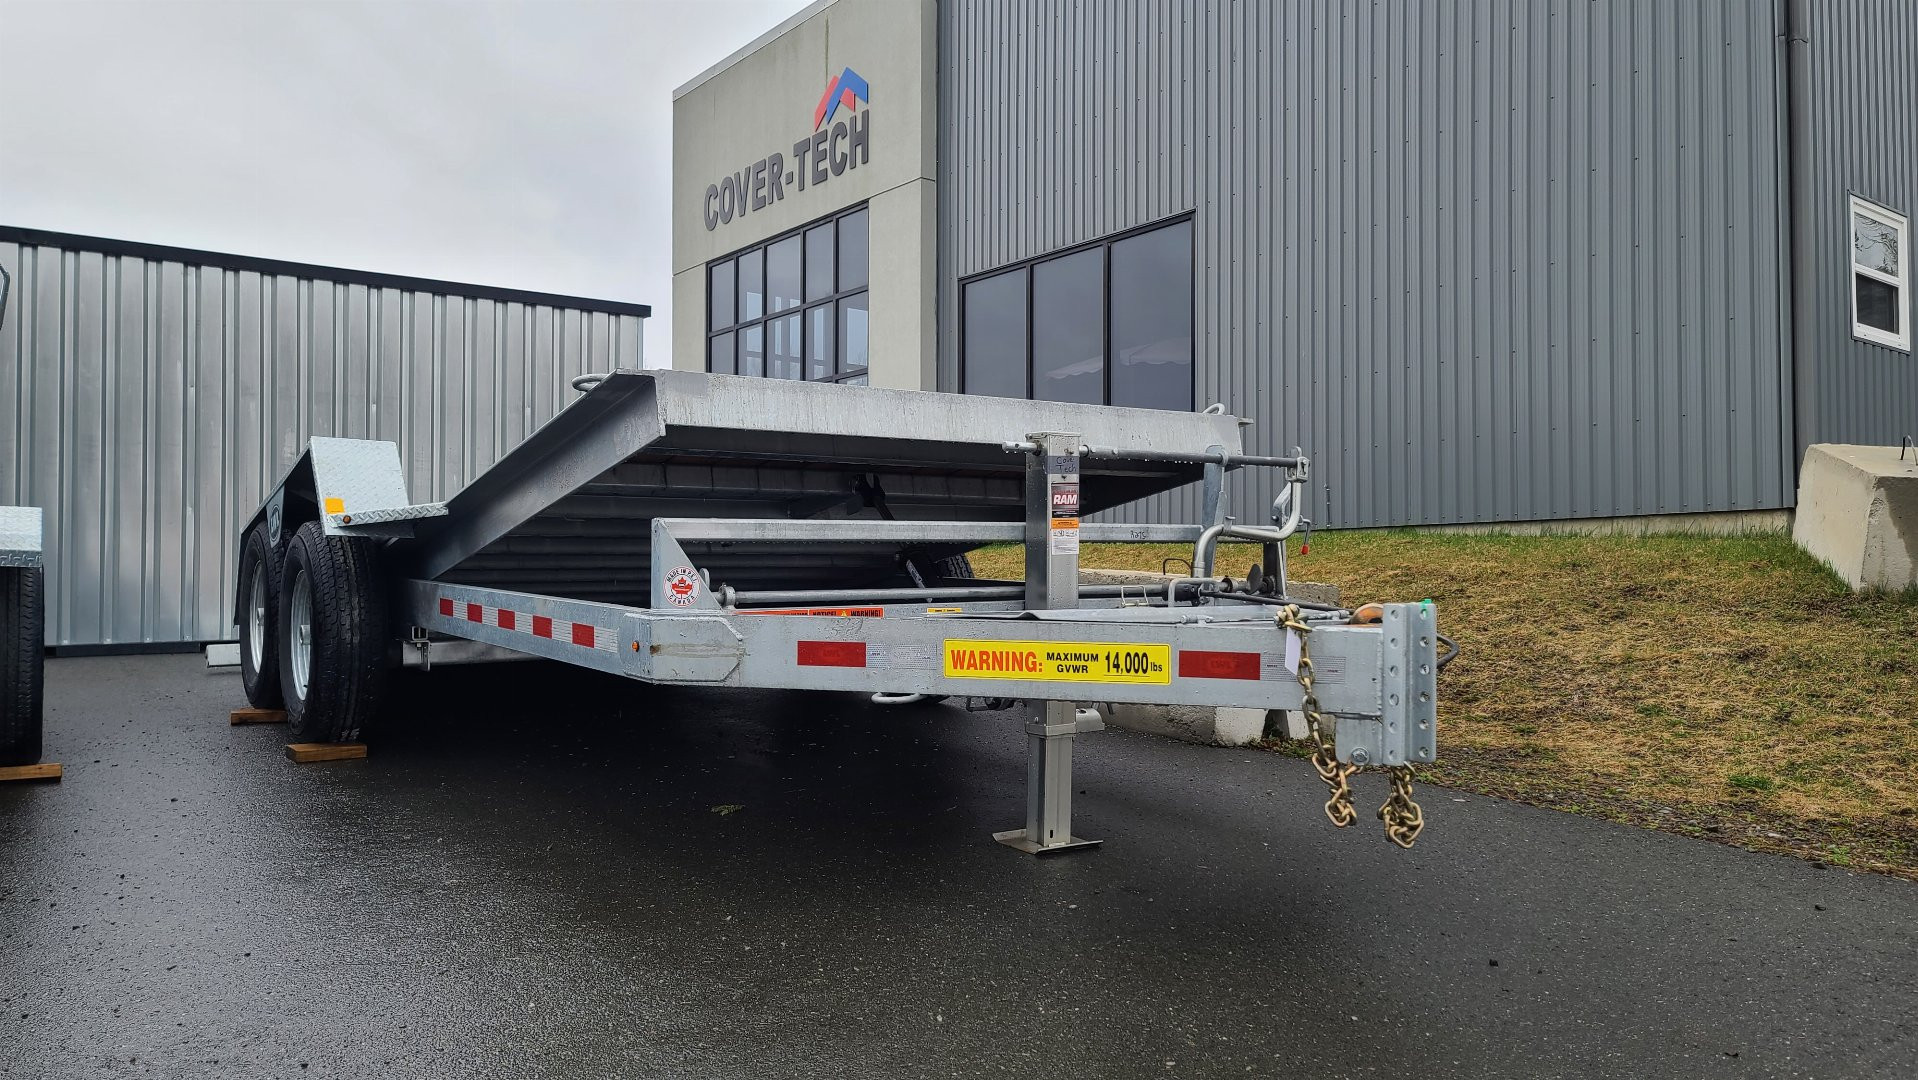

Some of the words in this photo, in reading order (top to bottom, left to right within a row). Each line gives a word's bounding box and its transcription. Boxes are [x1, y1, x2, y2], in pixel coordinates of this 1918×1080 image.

[704, 109, 869, 231] COVER-TECH
[1053, 494, 1078, 505] RAM
[666, 569, 680, 582] MADE
[669, 594, 696, 605] CANADA
[850, 609, 881, 618] WARNING!
[950, 649, 1043, 673] WARNING:
[1046, 652, 1099, 663] MAXIMUM
[1105, 651, 1149, 674] 14,000
[1150, 662, 1163, 672] lbs
[1056, 664, 1089, 674] GVWR
